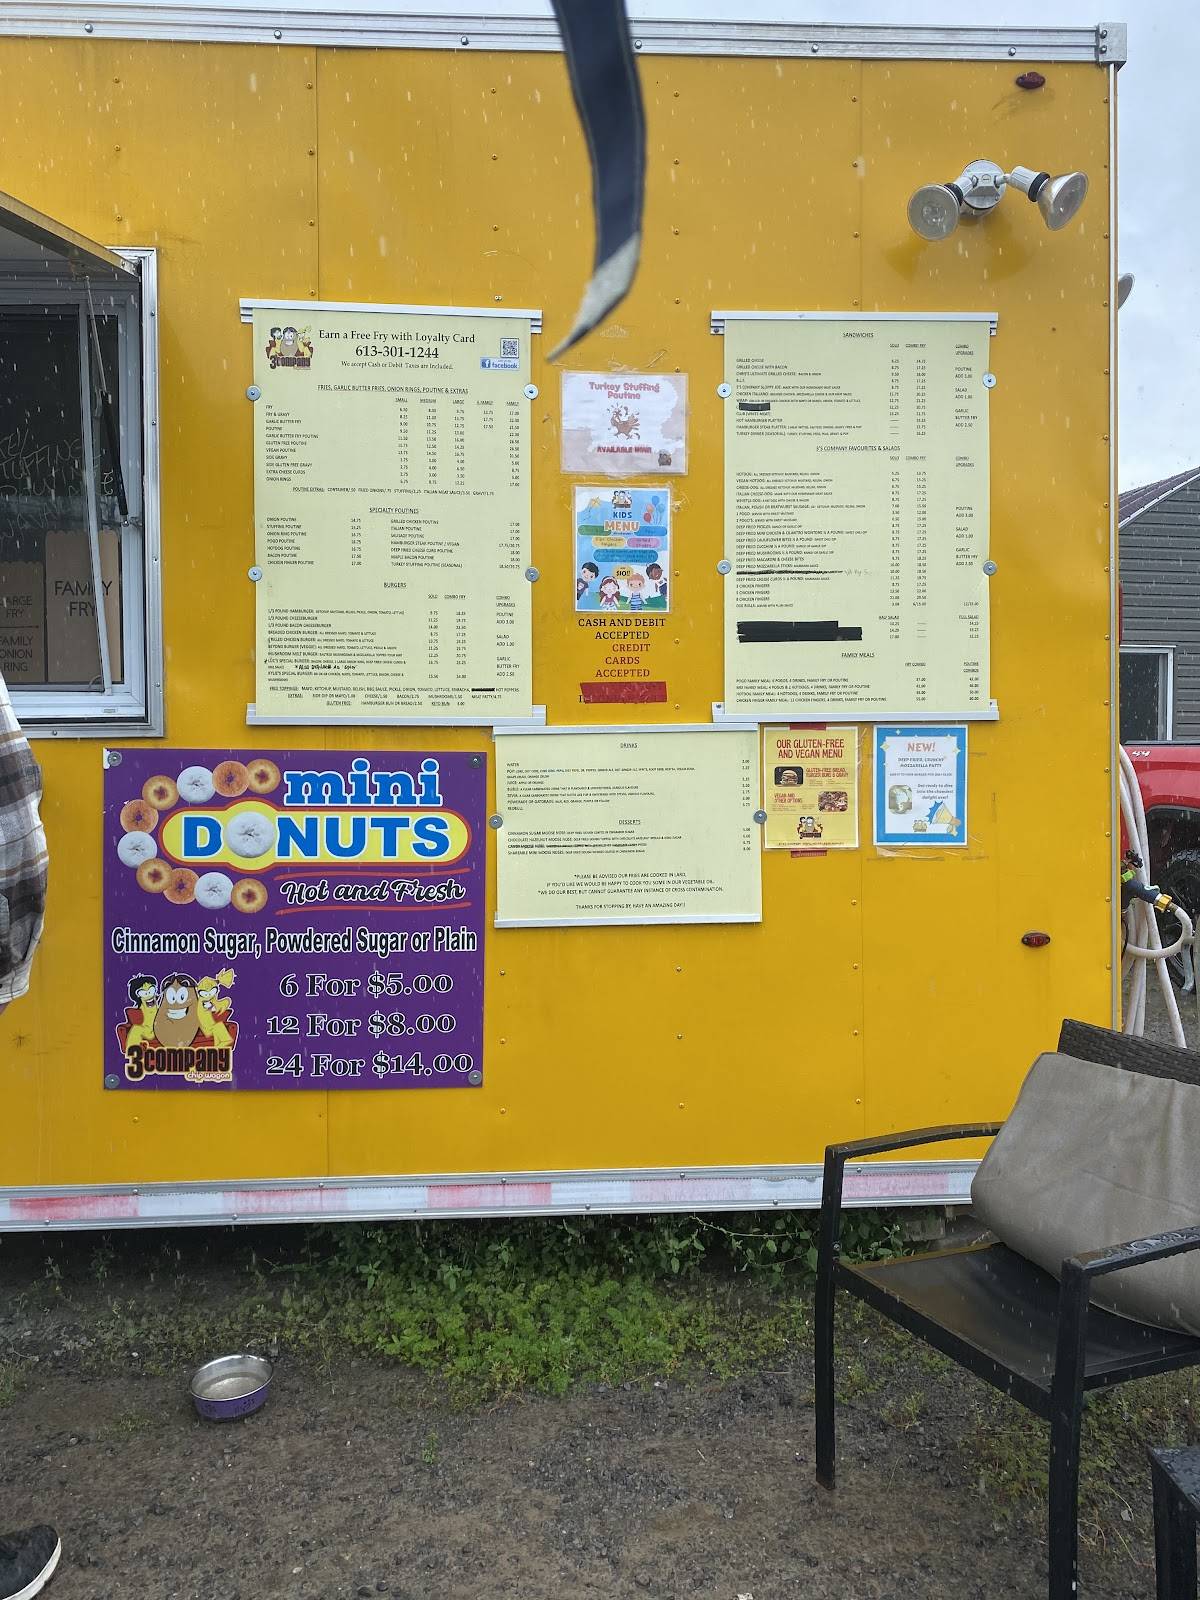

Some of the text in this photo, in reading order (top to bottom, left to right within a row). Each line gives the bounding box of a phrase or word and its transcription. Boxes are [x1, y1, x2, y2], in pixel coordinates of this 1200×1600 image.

[319, 329, 475, 345] Earn a Free Fry with Loyalty Card
[355, 345, 439, 359] 613-301-1244
[450, 387, 468, 395] EXTRAS
[589, 381, 660, 393] Turkey Stuffing
[608, 390, 641, 399] Poutine
[604, 520, 640, 531] MENU
[6, 609, 24, 618] FRY
[578, 618, 666, 627] CASH AND DEBIT
[595, 632, 650, 640] ACCEPTED
[612, 644, 651, 652] CREDIT
[605, 657, 640, 665] CARDS
[3, 662, 28, 672] RING
[595, 669, 650, 678] ACCEPTED
[776, 739, 844, 749] OUR GLUTEN-FREE
[907, 742, 935, 752] NEW!
[778, 749, 843, 758] AND VEGAN MENU
[284, 758, 443, 806] mini
[181, 815, 451, 859] DONUTS
[280, 879, 465, 904] Hot and Fresh
[112, 926, 477, 959] Cinnamon Sugar, Powdered Sugar or Plain
[279, 972, 453, 998] 6 For $5.00
[267, 1010, 456, 1037] 12 For $8.00
[266, 1052, 474, 1078] 24 For $14.00
[187, 1072, 230, 1082] chip wagon
